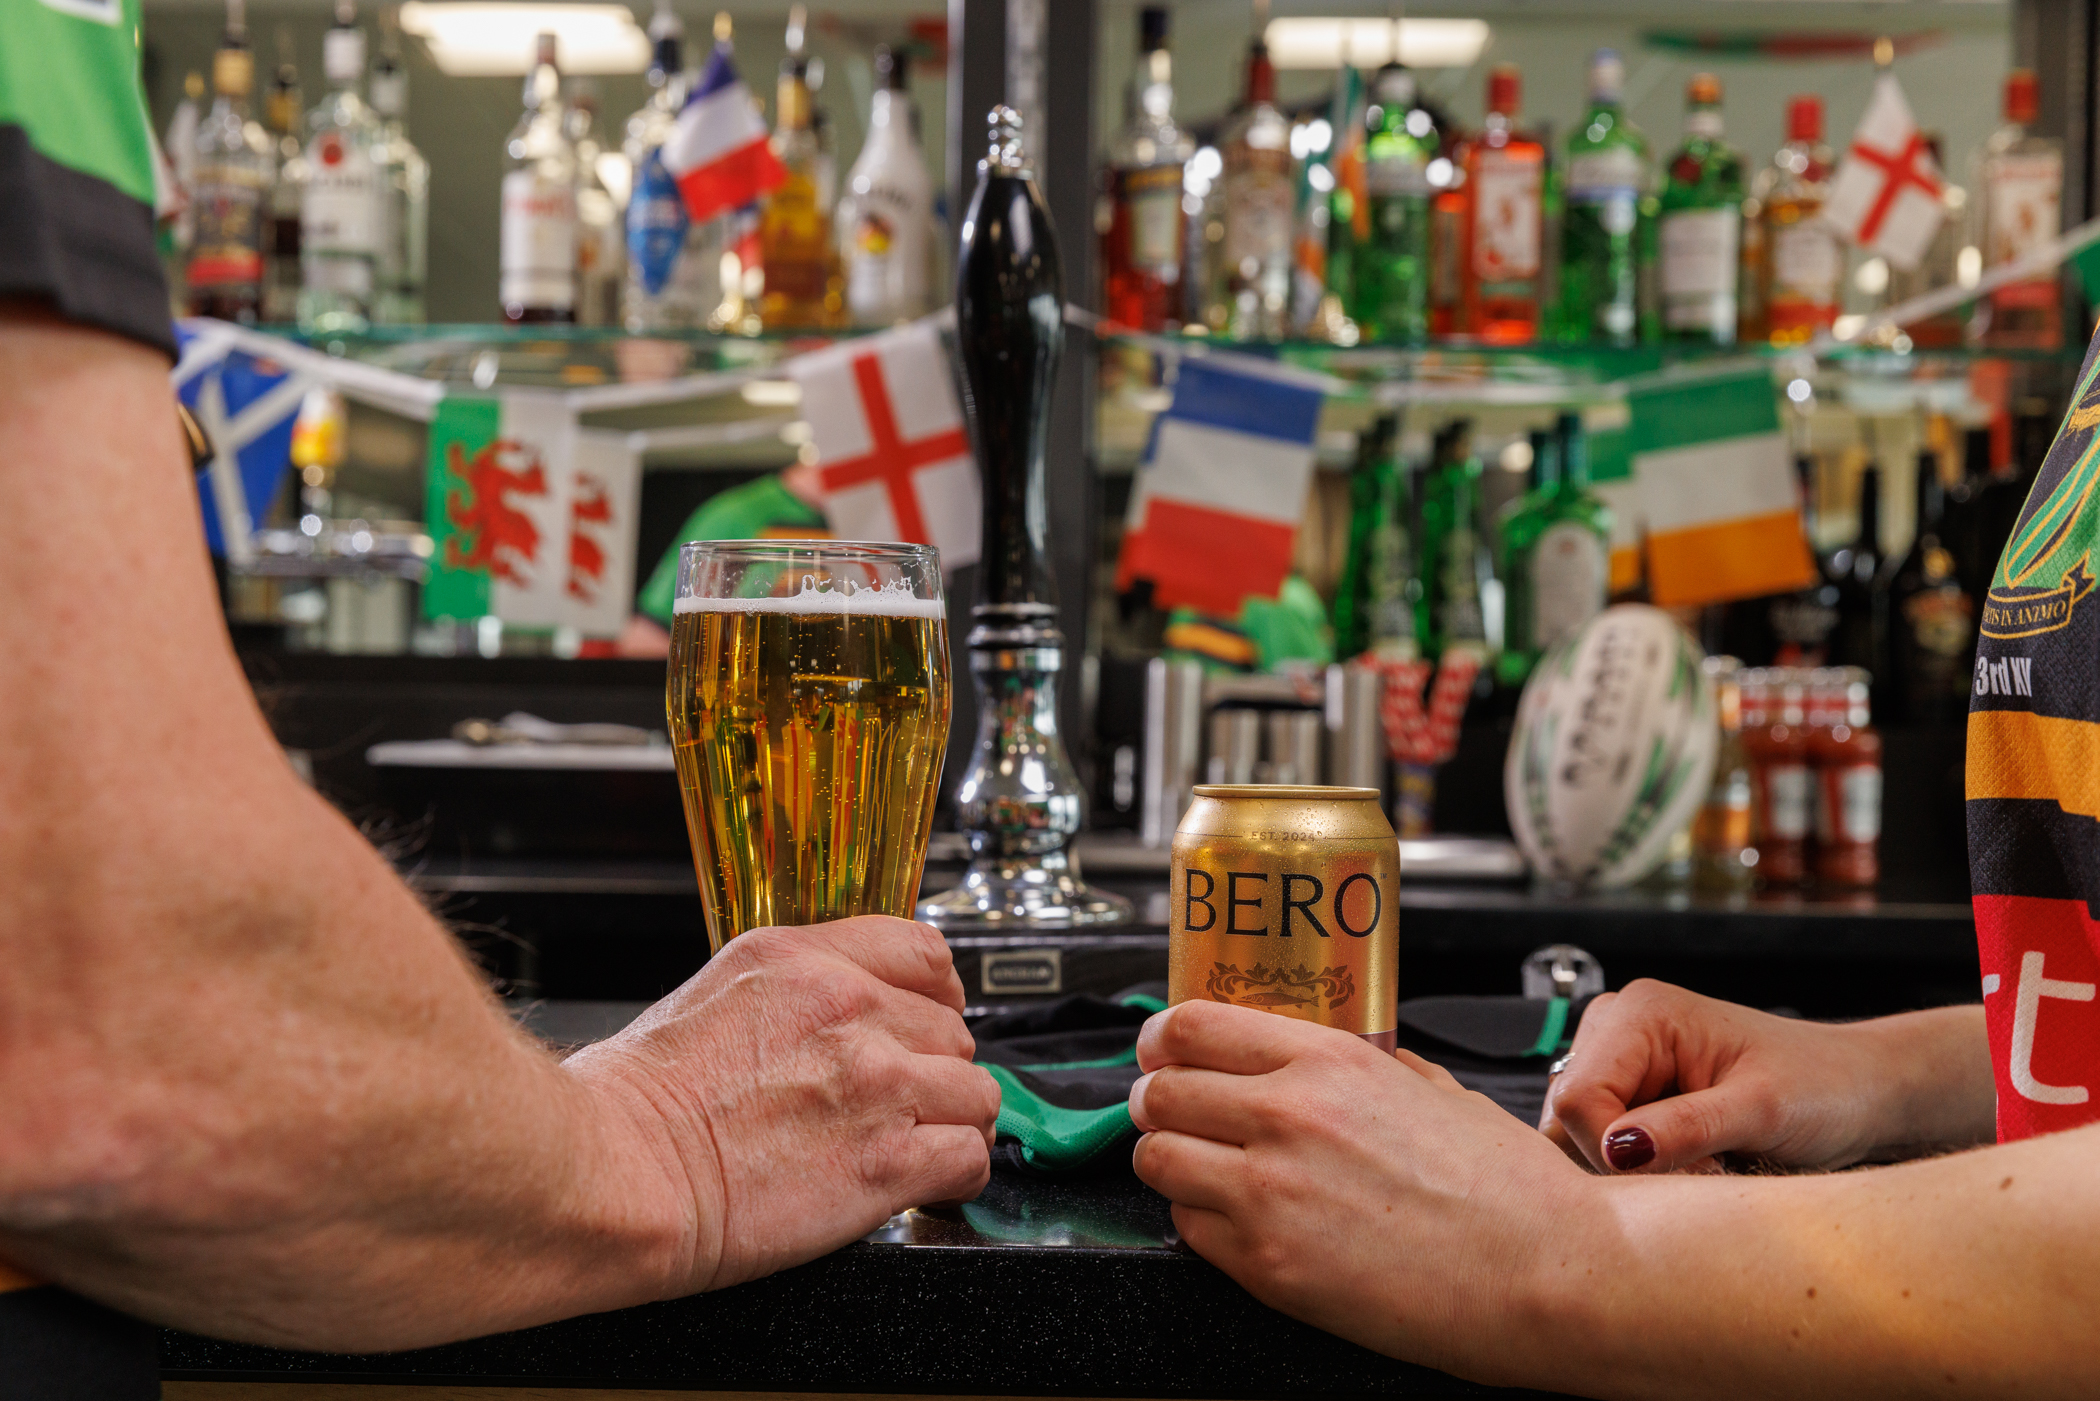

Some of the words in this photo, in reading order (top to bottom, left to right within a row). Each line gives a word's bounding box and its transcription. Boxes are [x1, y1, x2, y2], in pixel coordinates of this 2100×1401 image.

[2001, 609, 2013, 627] IN
[2014, 600, 2067, 625] ANIMO
[1975, 656, 2012, 696] 3rd
[2010, 656, 2033, 698] XV
[1251, 830, 1278, 841] EST.
[1282, 831, 1315, 842] 2024
[1184, 868, 1382, 939] BERO
[1982, 950, 2096, 1105] t
